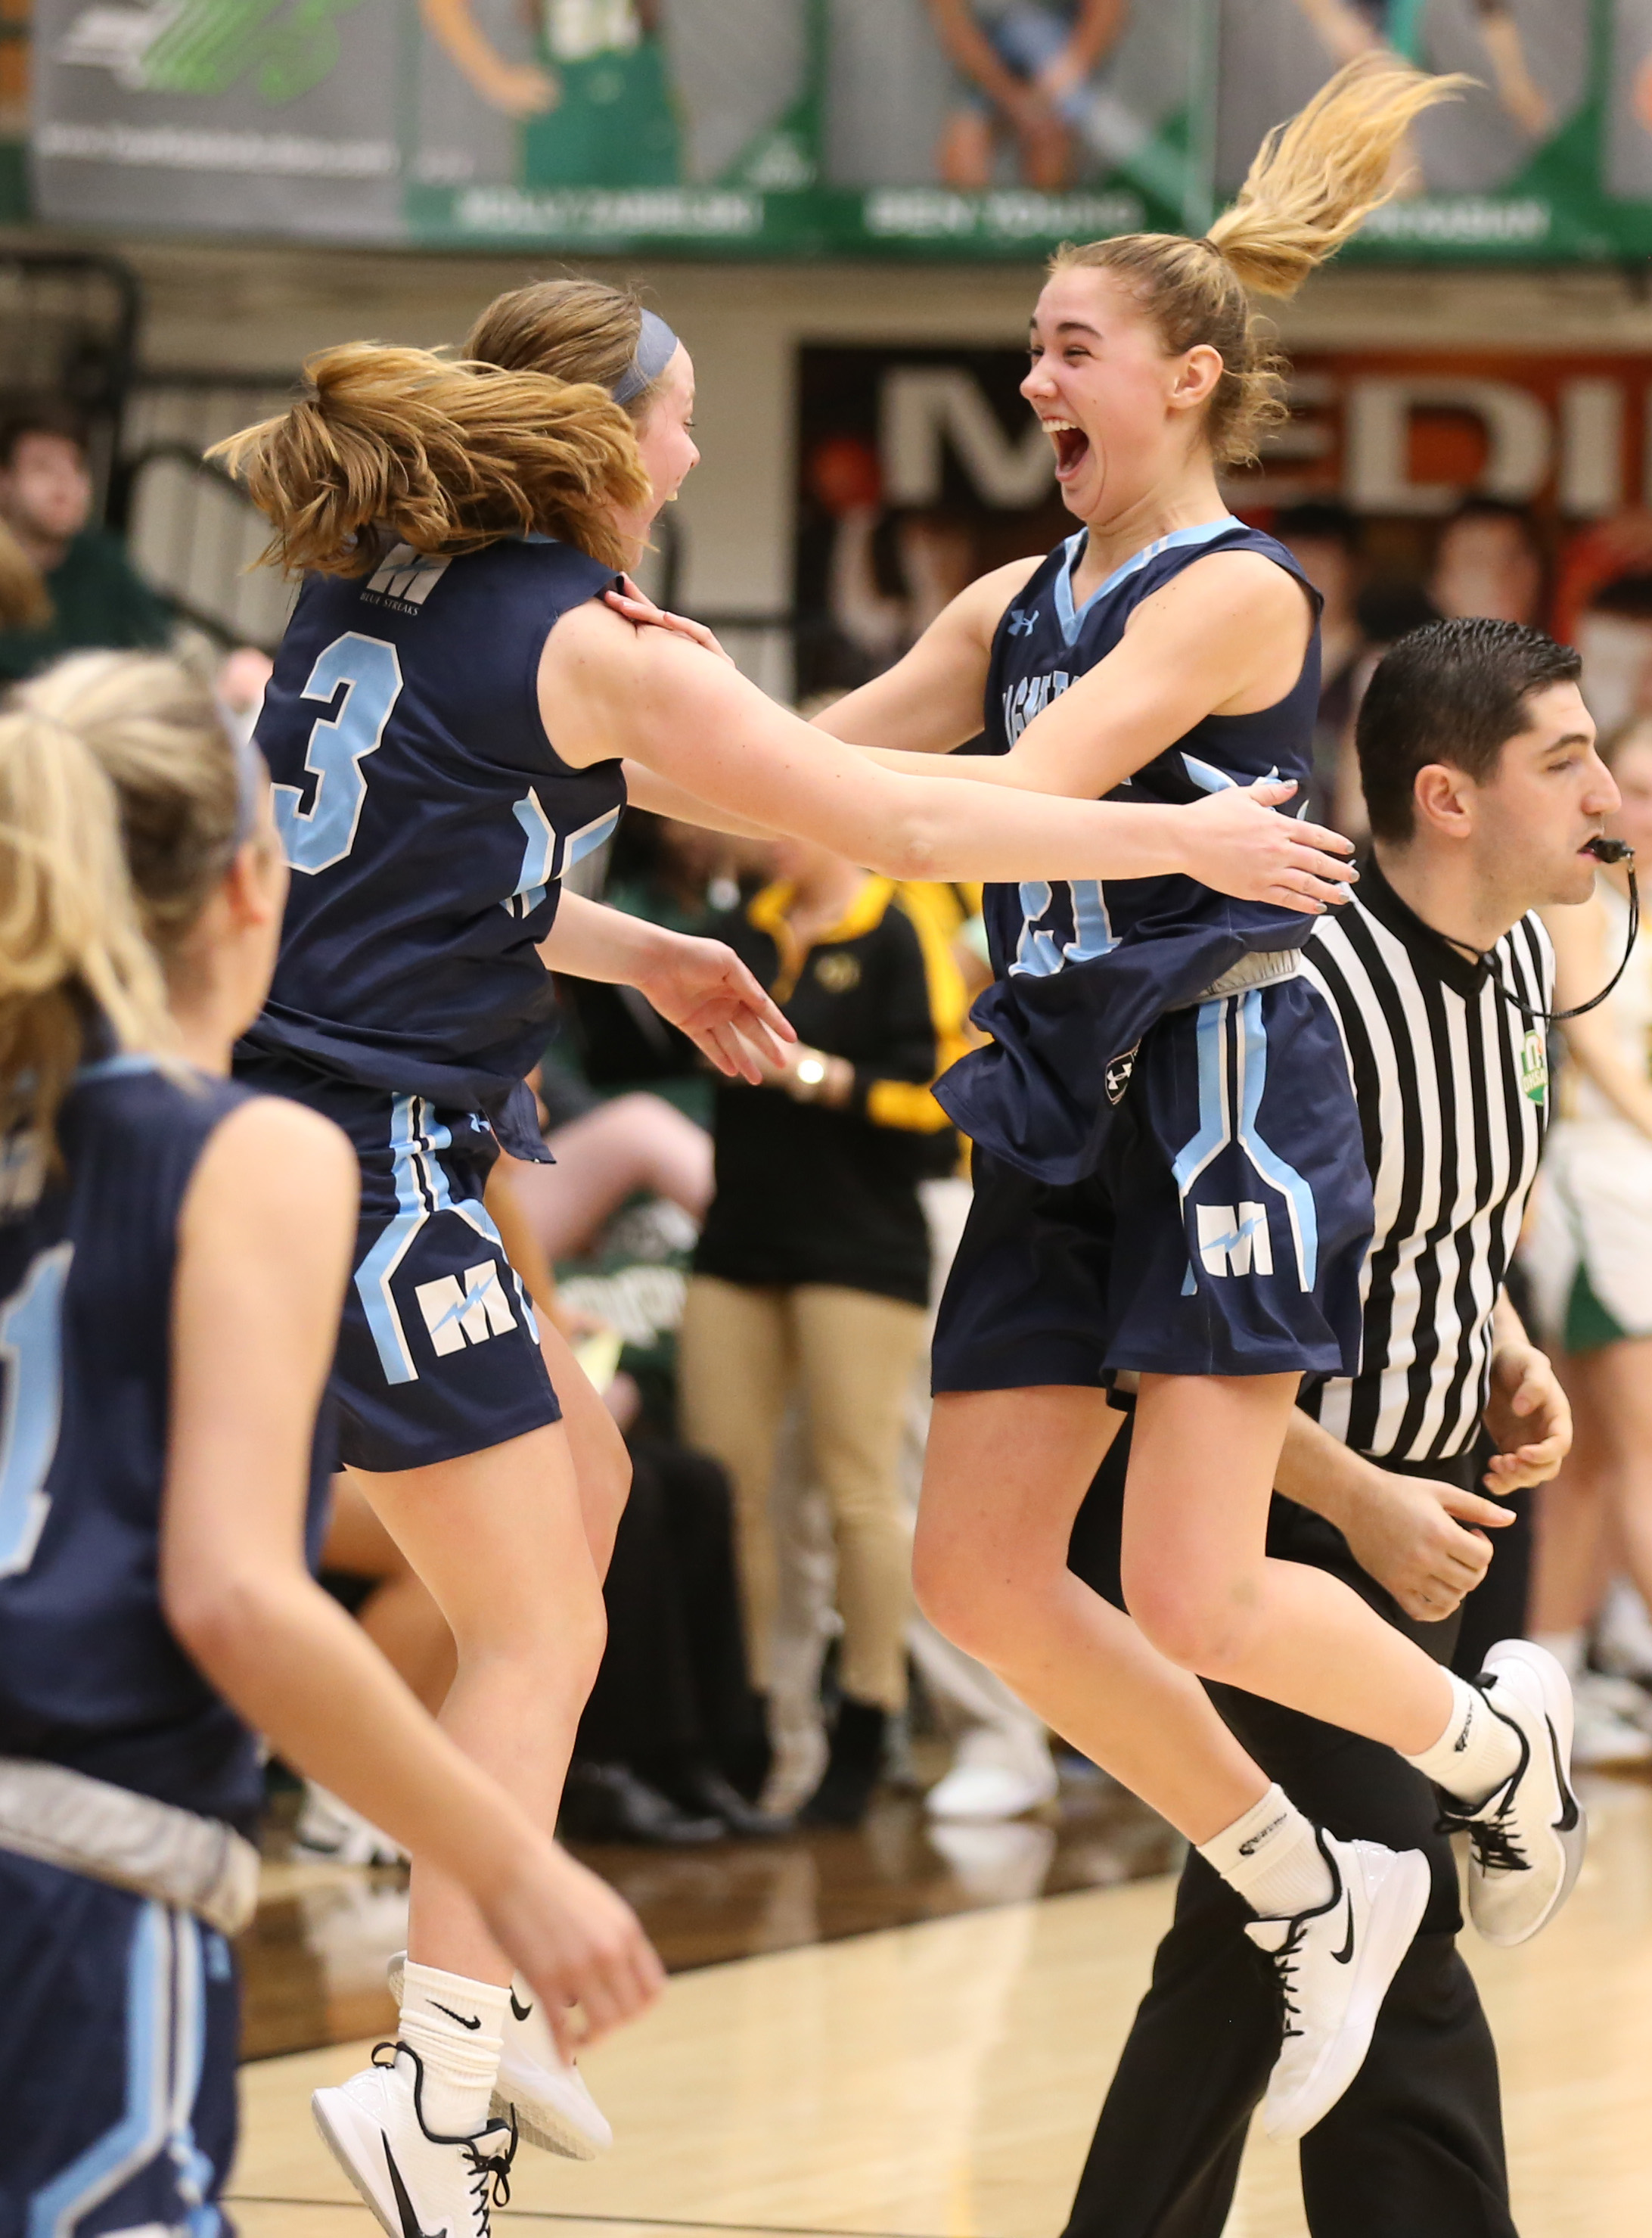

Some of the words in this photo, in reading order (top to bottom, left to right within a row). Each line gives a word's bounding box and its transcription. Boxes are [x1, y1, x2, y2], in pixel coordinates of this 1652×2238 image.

[877, 365, 1652, 521] MEDI
[384, 598, 420, 616] STREAKS
[270, 631, 404, 875] 3
[1195, 1201, 1274, 1278] M
[415, 1259, 518, 1357] M
